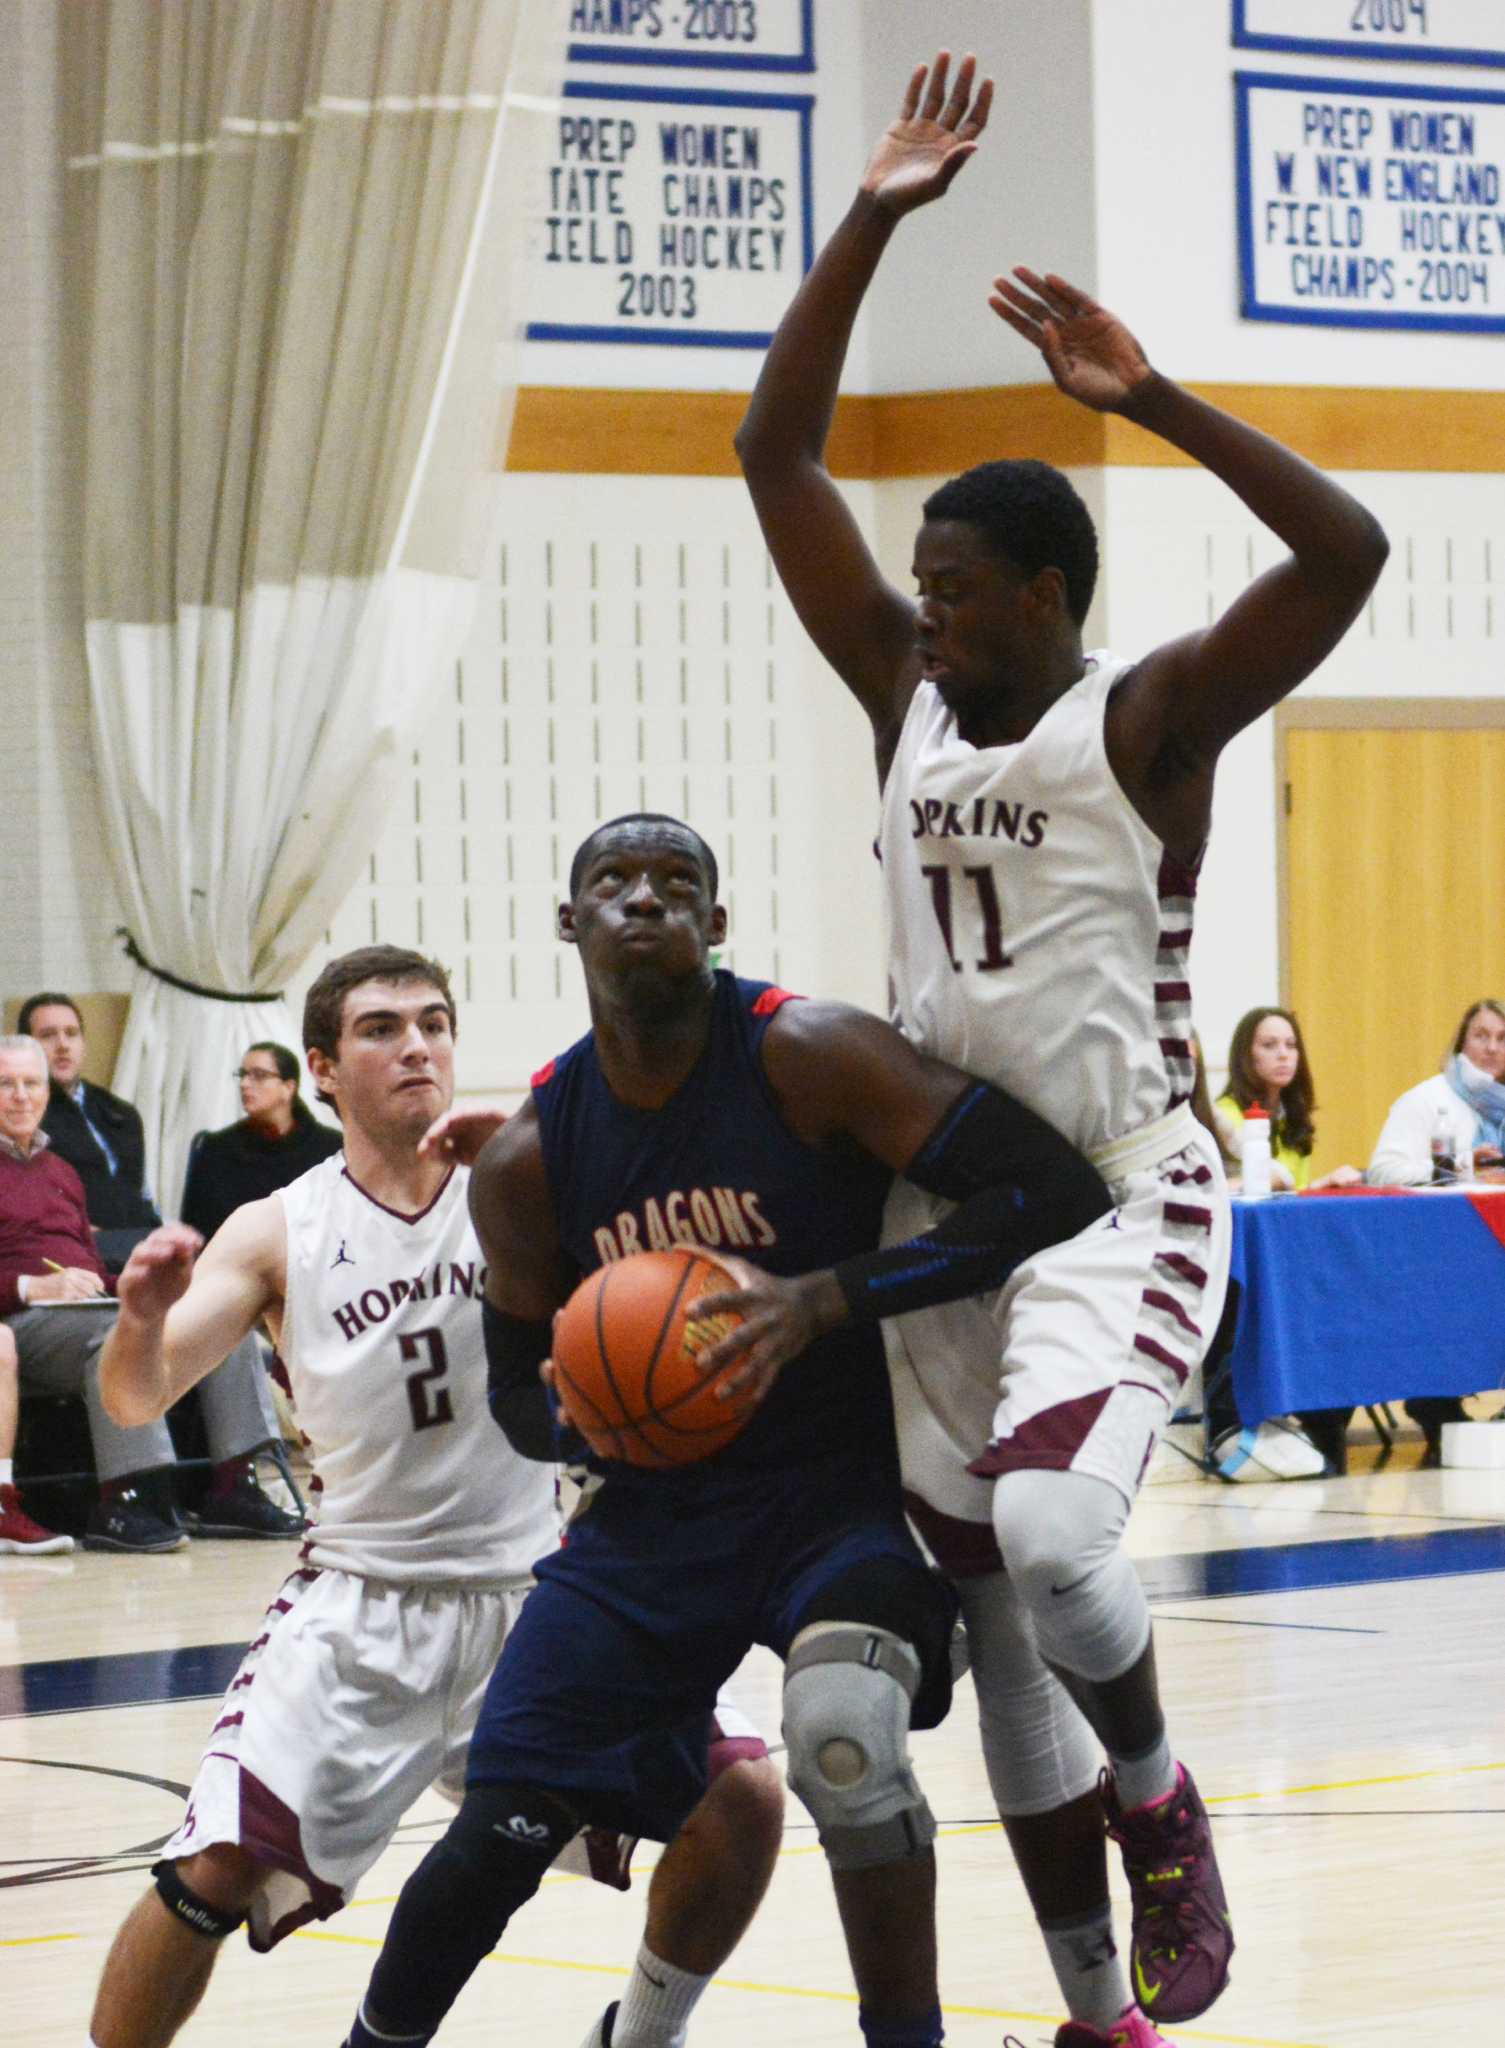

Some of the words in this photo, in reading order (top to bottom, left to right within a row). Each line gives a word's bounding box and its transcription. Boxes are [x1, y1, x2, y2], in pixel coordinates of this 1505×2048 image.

[1350, 0, 1428, 34] 2004
[560, 116, 636, 162] PREP
[659, 122, 759, 169] WOMEN
[1303, 104, 1372, 150] PREP
[1389, 109, 1475, 155] WOMEN
[549, 167, 625, 214] TATE
[663, 174, 785, 222] CHAMPS
[1275, 151, 1295, 195] W
[1316, 155, 1371, 200] NEW
[1385, 158, 1499, 206] ENGLAND
[545, 217, 633, 265] IELD
[659, 224, 785, 272] HOCKEY
[1266, 201, 1363, 248] FIELD
[1401, 209, 1505, 255] HOCKEY
[618, 272, 697, 319] 2003
[909, 797, 1049, 848] OPKINS
[921, 864, 1014, 973] 11
[594, 1186, 777, 1266] DRAGONS
[397, 1326, 454, 1432] 2
